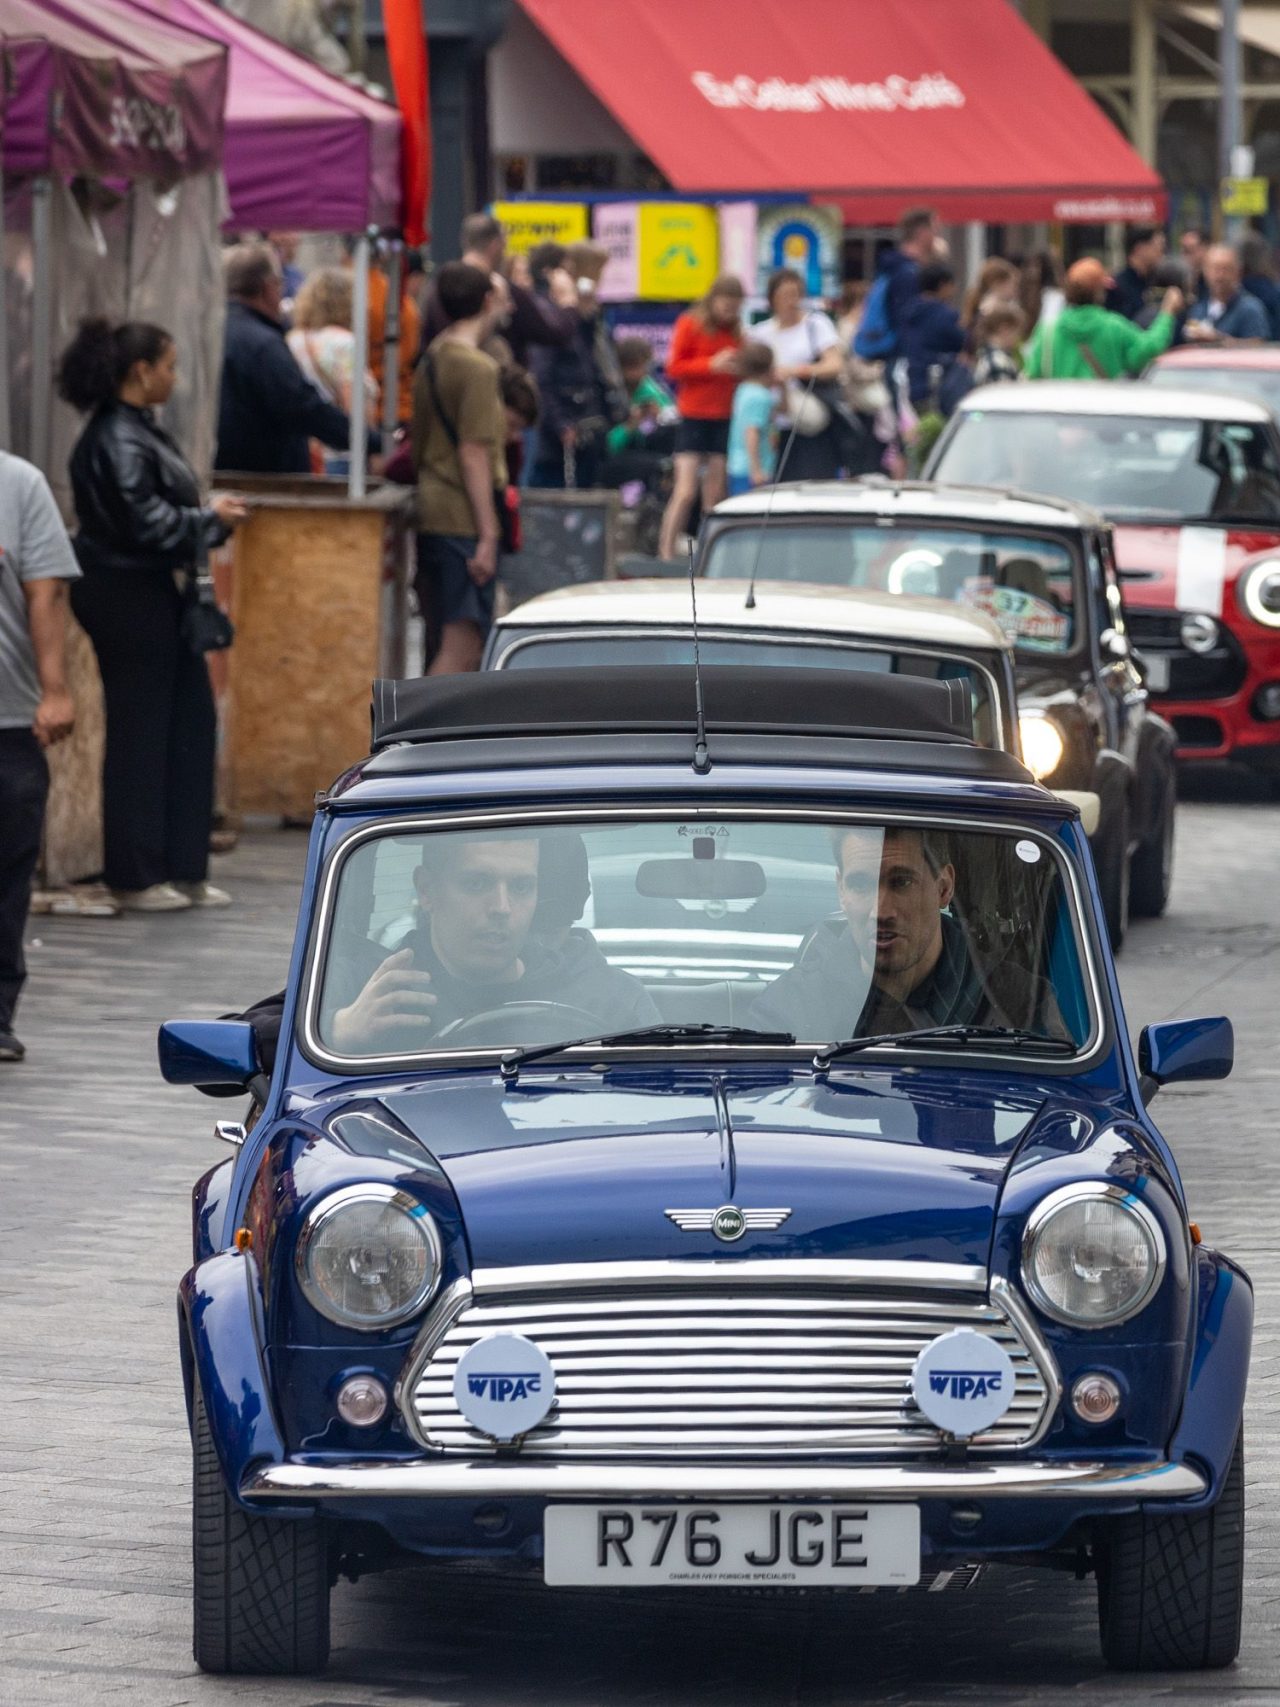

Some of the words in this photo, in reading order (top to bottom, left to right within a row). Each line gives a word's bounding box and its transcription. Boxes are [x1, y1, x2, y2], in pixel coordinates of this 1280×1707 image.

[467, 1378, 541, 1402] WIPAC
[929, 1375, 1002, 1400] WIPAC
[598, 1510, 721, 1567] R76
[744, 1510, 868, 1567] JGE
[753, 1572, 796, 1580] SPECIALISTS
